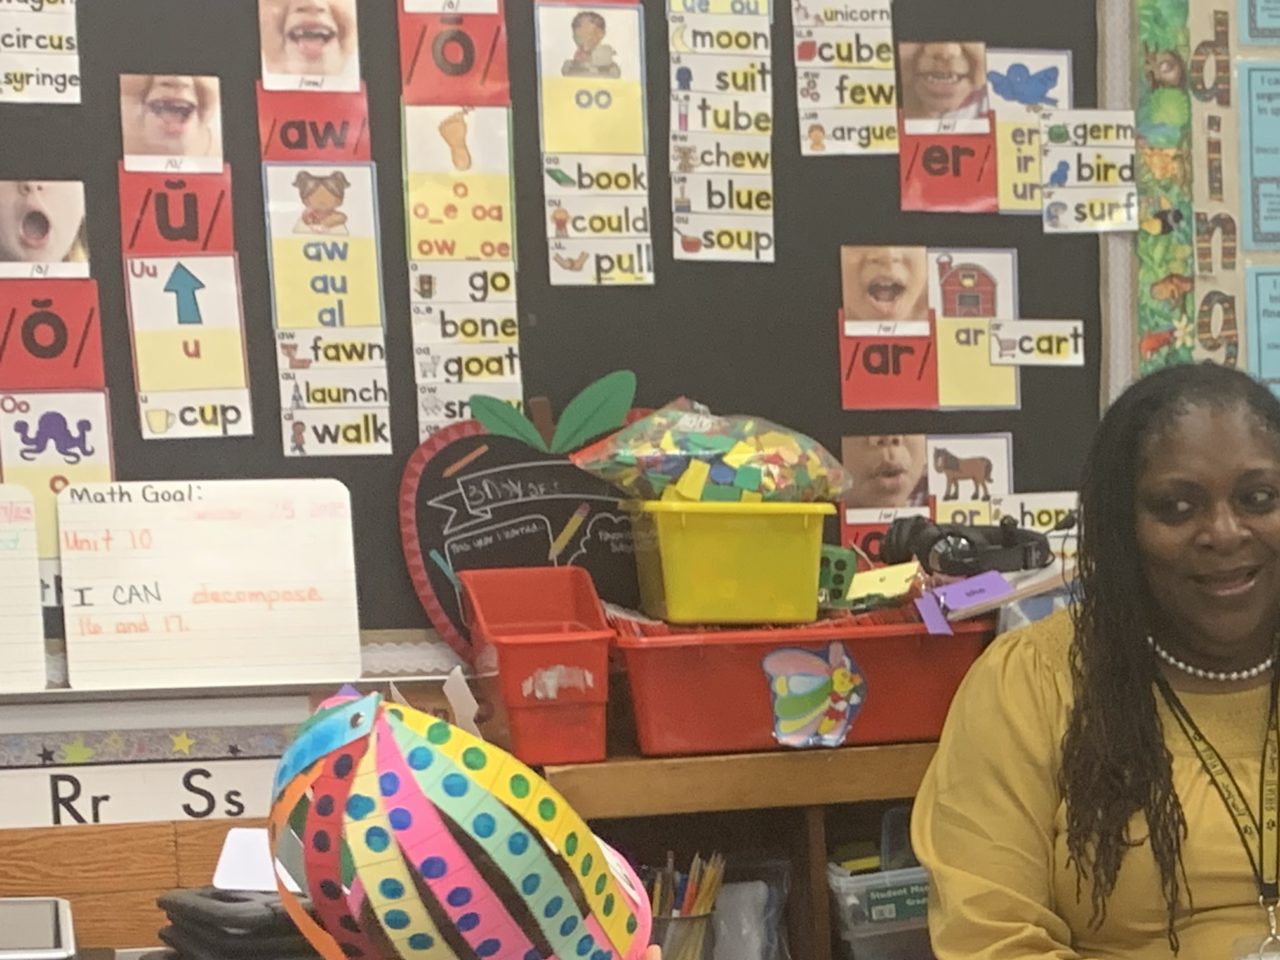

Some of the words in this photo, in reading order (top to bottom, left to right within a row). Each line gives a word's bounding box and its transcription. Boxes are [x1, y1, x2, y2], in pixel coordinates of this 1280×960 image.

[824, 8, 890, 22] unicorn
[1, 27, 76, 50] circus
[692, 29, 768, 49] moon
[817, 33, 893, 63] cube
[4, 67, 80, 93] syringe
[715, 64, 771, 91] suit
[836, 75, 895, 104] few
[575, 90, 612, 109] oo
[698, 98, 772, 132] tube
[831, 123, 896, 145] argue
[1011, 127, 1040, 146] er
[1073, 122, 1135, 146] germ
[700, 143, 769, 168] chew
[1017, 148, 1035, 173] ir
[1077, 152, 1135, 182] bird
[577, 164, 647, 191] book
[453, 182, 468, 198] o
[706, 180, 771, 210] blue
[1013, 182, 1042, 200] ur
[472, 205, 503, 222] oa
[1074, 192, 1136, 222] surf
[572, 211, 649, 233] could
[303, 242, 348, 261] aw
[418, 240, 456, 256] ow
[702, 227, 773, 259] soup
[130, 260, 158, 279] Uu
[595, 244, 653, 275] pull
[310, 276, 347, 294] au
[469, 271, 510, 302] go
[318, 302, 344, 326] al
[441, 310, 518, 340] bone
[955, 325, 985, 346] ar
[1018, 326, 1084, 354] cart
[183, 339, 201, 358] u
[311, 336, 385, 362] fawn
[444, 347, 519, 383] goat
[305, 378, 388, 405] launch
[1, 397, 30, 413] Oo
[179, 402, 241, 435] cup
[312, 409, 389, 445] walk
[70, 487, 131, 503] Math
[142, 485, 203, 502] Goal:
[951, 509, 981, 525] or
[64, 530, 113, 551] Unit
[129, 529, 152, 550] 10
[72, 587, 94, 607] I
[112, 581, 162, 605] CAN
[191, 583, 323, 610] decompose
[115, 614, 148, 633] and
[50, 774, 110, 825] Rr
[182, 768, 244, 818] Ss
[870, 887, 907, 899] Student
